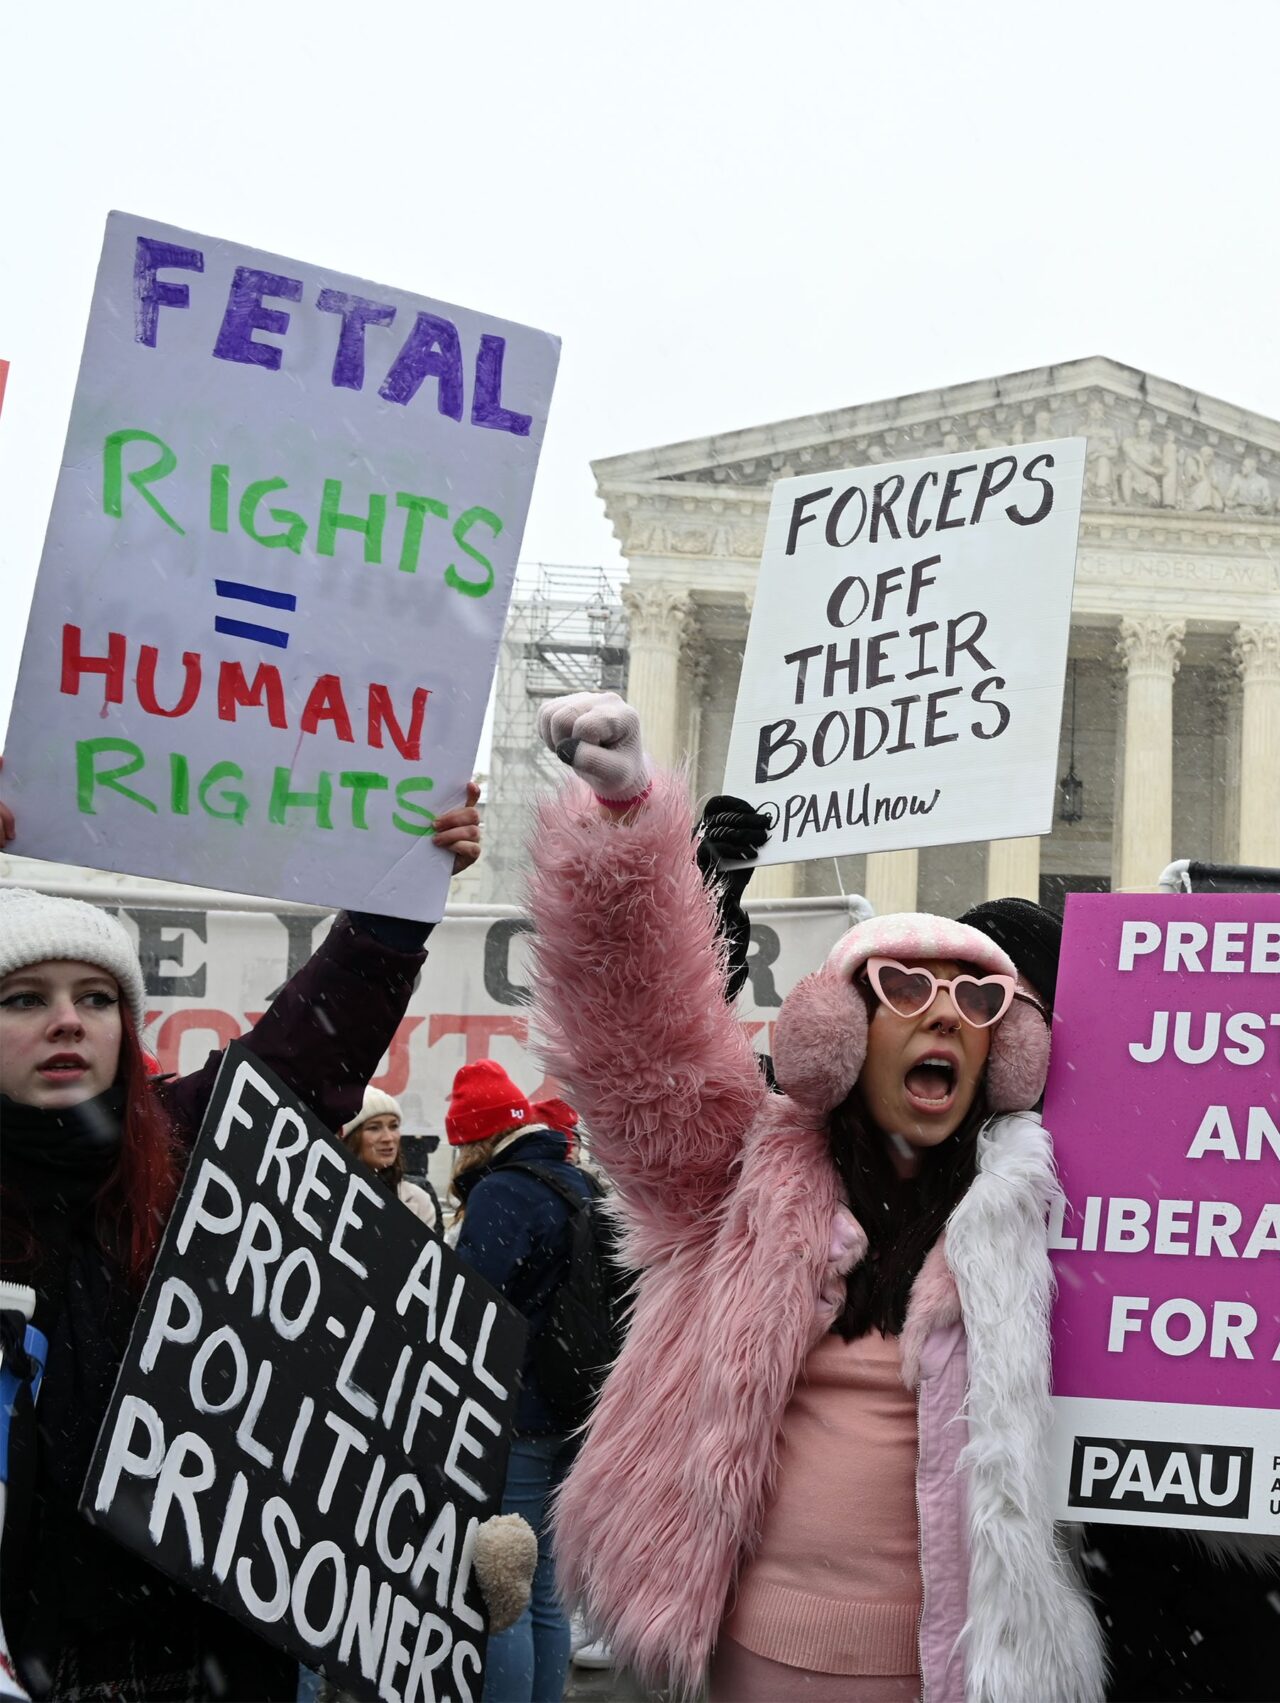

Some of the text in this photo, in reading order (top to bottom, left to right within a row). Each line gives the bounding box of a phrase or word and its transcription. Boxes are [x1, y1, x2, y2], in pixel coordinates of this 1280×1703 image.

[134, 236, 532, 436] FETAL
[103, 428, 502, 598] RIGHTS
[785, 454, 1055, 556] FORCEPS
[825, 554, 941, 628] OFF
[1119, 557, 1198, 580] UNDER
[1210, 564, 1255, 583] LAW
[60, 622, 432, 761] HUMAN
[784, 611, 997, 704] THEIR
[755, 676, 1010, 784] BODIES
[75, 736, 438, 836] RIGHTS
[214, 1062, 508, 1400] FREE ALL
[176, 1160, 501, 1502] PRO-LIFE
[1108, 1295, 1257, 1361] FOR
[139, 1277, 484, 1632] POLITICAL
[1079, 1446, 1242, 1508] PAAU
[94, 1395, 482, 1703] PRISONERS
